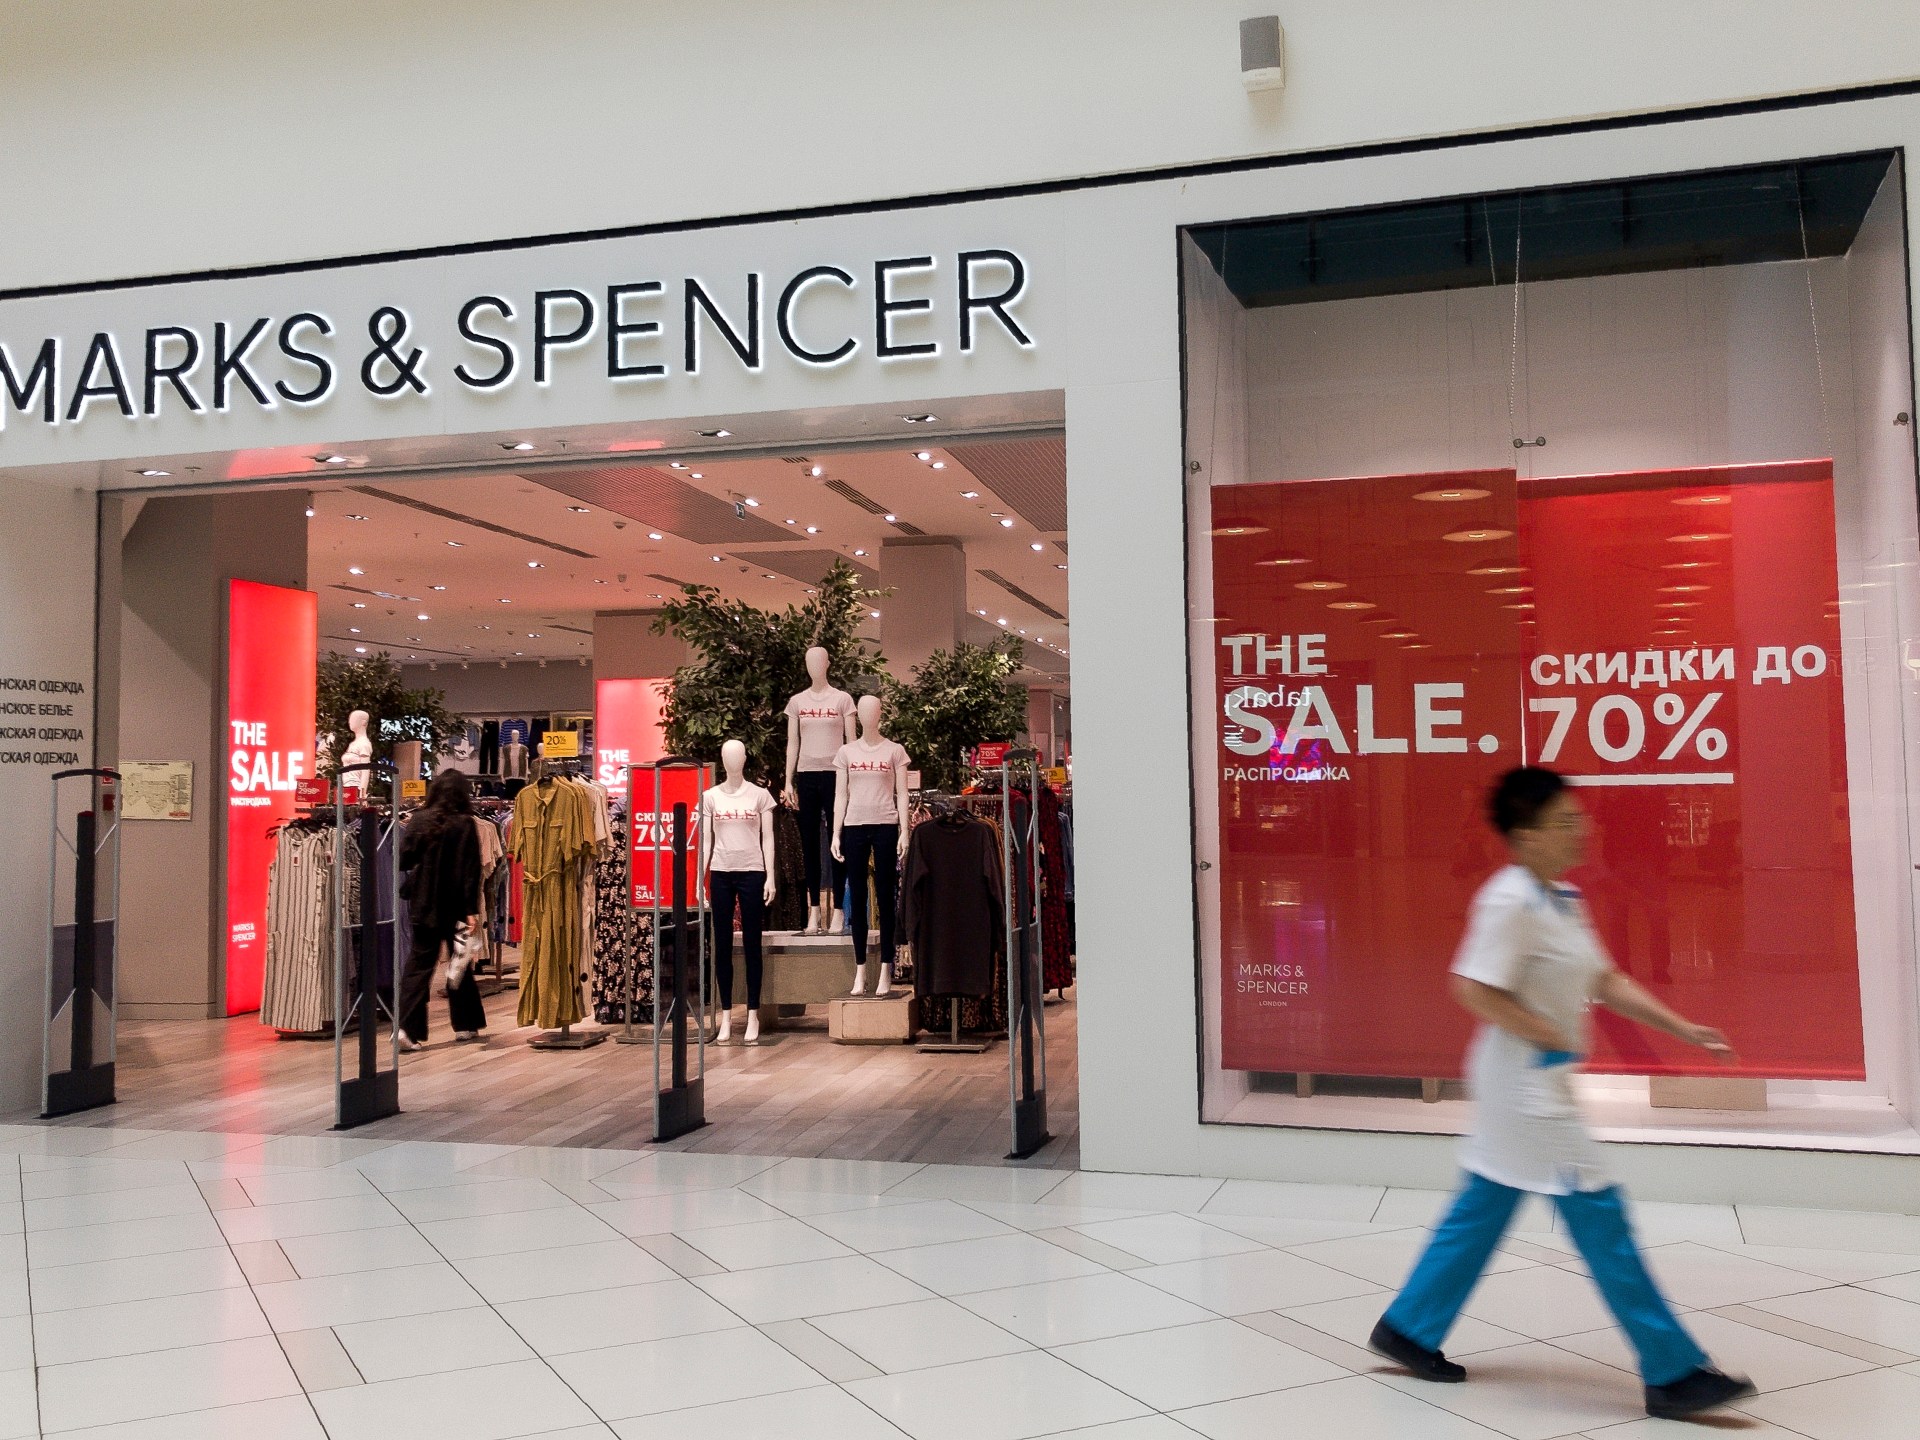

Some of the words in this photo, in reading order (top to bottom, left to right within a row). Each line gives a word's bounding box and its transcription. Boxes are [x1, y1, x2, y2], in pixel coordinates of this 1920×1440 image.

[0, 312, 334, 423] MARKS
[360, 306, 430, 395] &
[453, 248, 1033, 390] SPENCER
[1221, 633, 1328, 676] THE
[1530, 648, 1736, 689] СКИДКИ
[1752, 645, 1827, 685] ДО
[39, 681, 84, 695] ОДЕЖДА
[39, 704, 74, 716] БЕЛЬЕ
[1223, 683, 1499, 756] SALE.
[38, 728, 84, 742] ОДЕЖДА
[231, 720, 267, 746] THE
[1529, 692, 1729, 763] 70%
[546, 735, 567, 745] 20%
[33, 752, 79, 766] ОДЕЖДА
[599, 749, 630, 762] THE
[231, 751, 303, 791] SALE
[1223, 767, 1350, 783] РАСПРОДАЖА
[1240, 964, 1291, 976] MARKS
[1294, 965, 1304, 977] &
[1237, 980, 1308, 995] SPENCER
